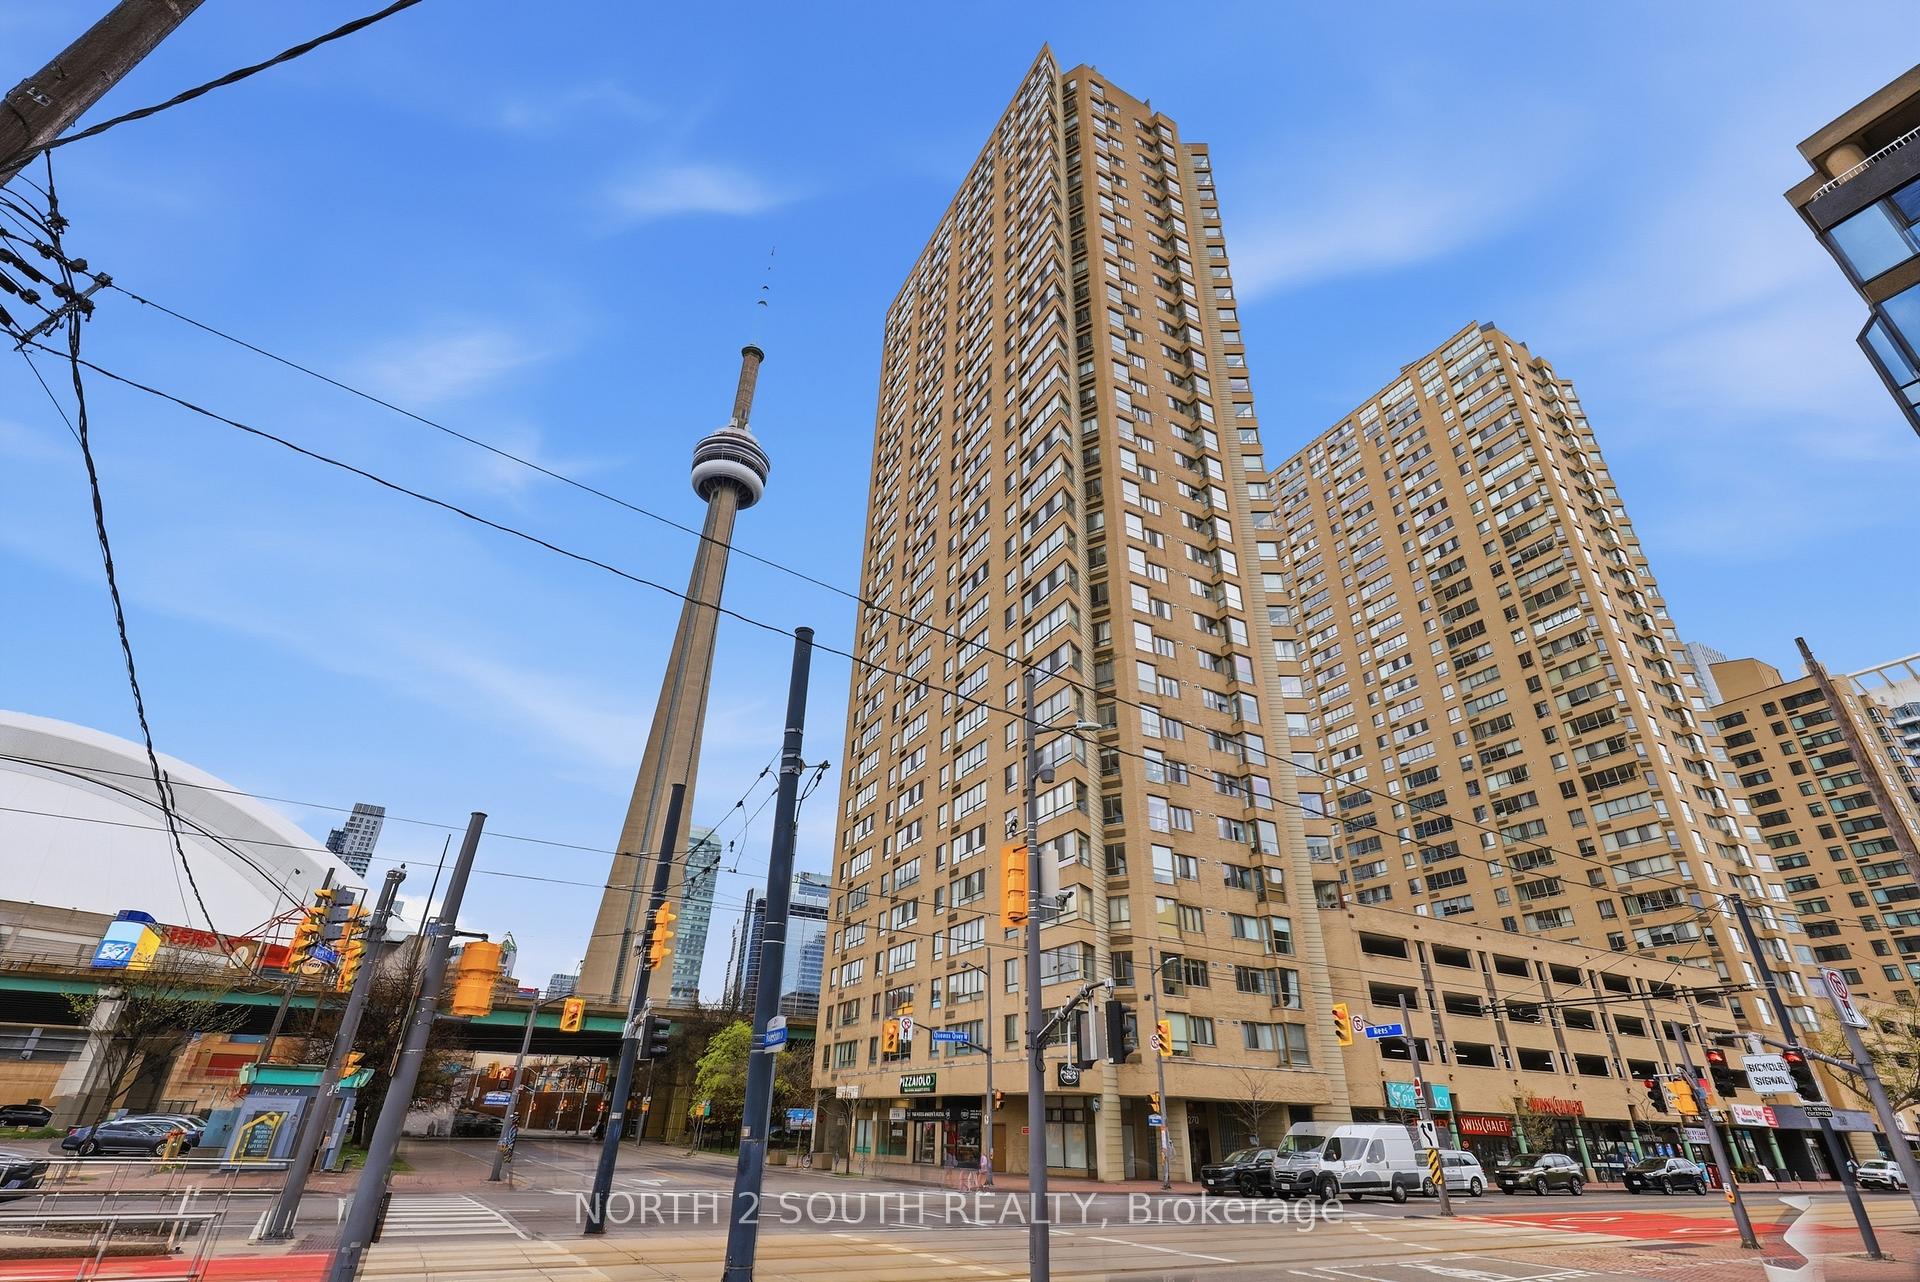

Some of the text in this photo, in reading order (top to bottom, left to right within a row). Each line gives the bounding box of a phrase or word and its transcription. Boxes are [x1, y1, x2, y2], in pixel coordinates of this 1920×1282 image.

[933, 1031, 951, 1039] Queens
[952, 1032, 963, 1040] Quay
[1373, 1027, 1388, 1035] Rees
[1746, 1062, 1787, 1072] BICYCLE
[900, 1074, 931, 1088] PIZZAIOLO
[1754, 1076, 1789, 1085] SIGNAL
[1402, 1094, 1448, 1109] PHCY
